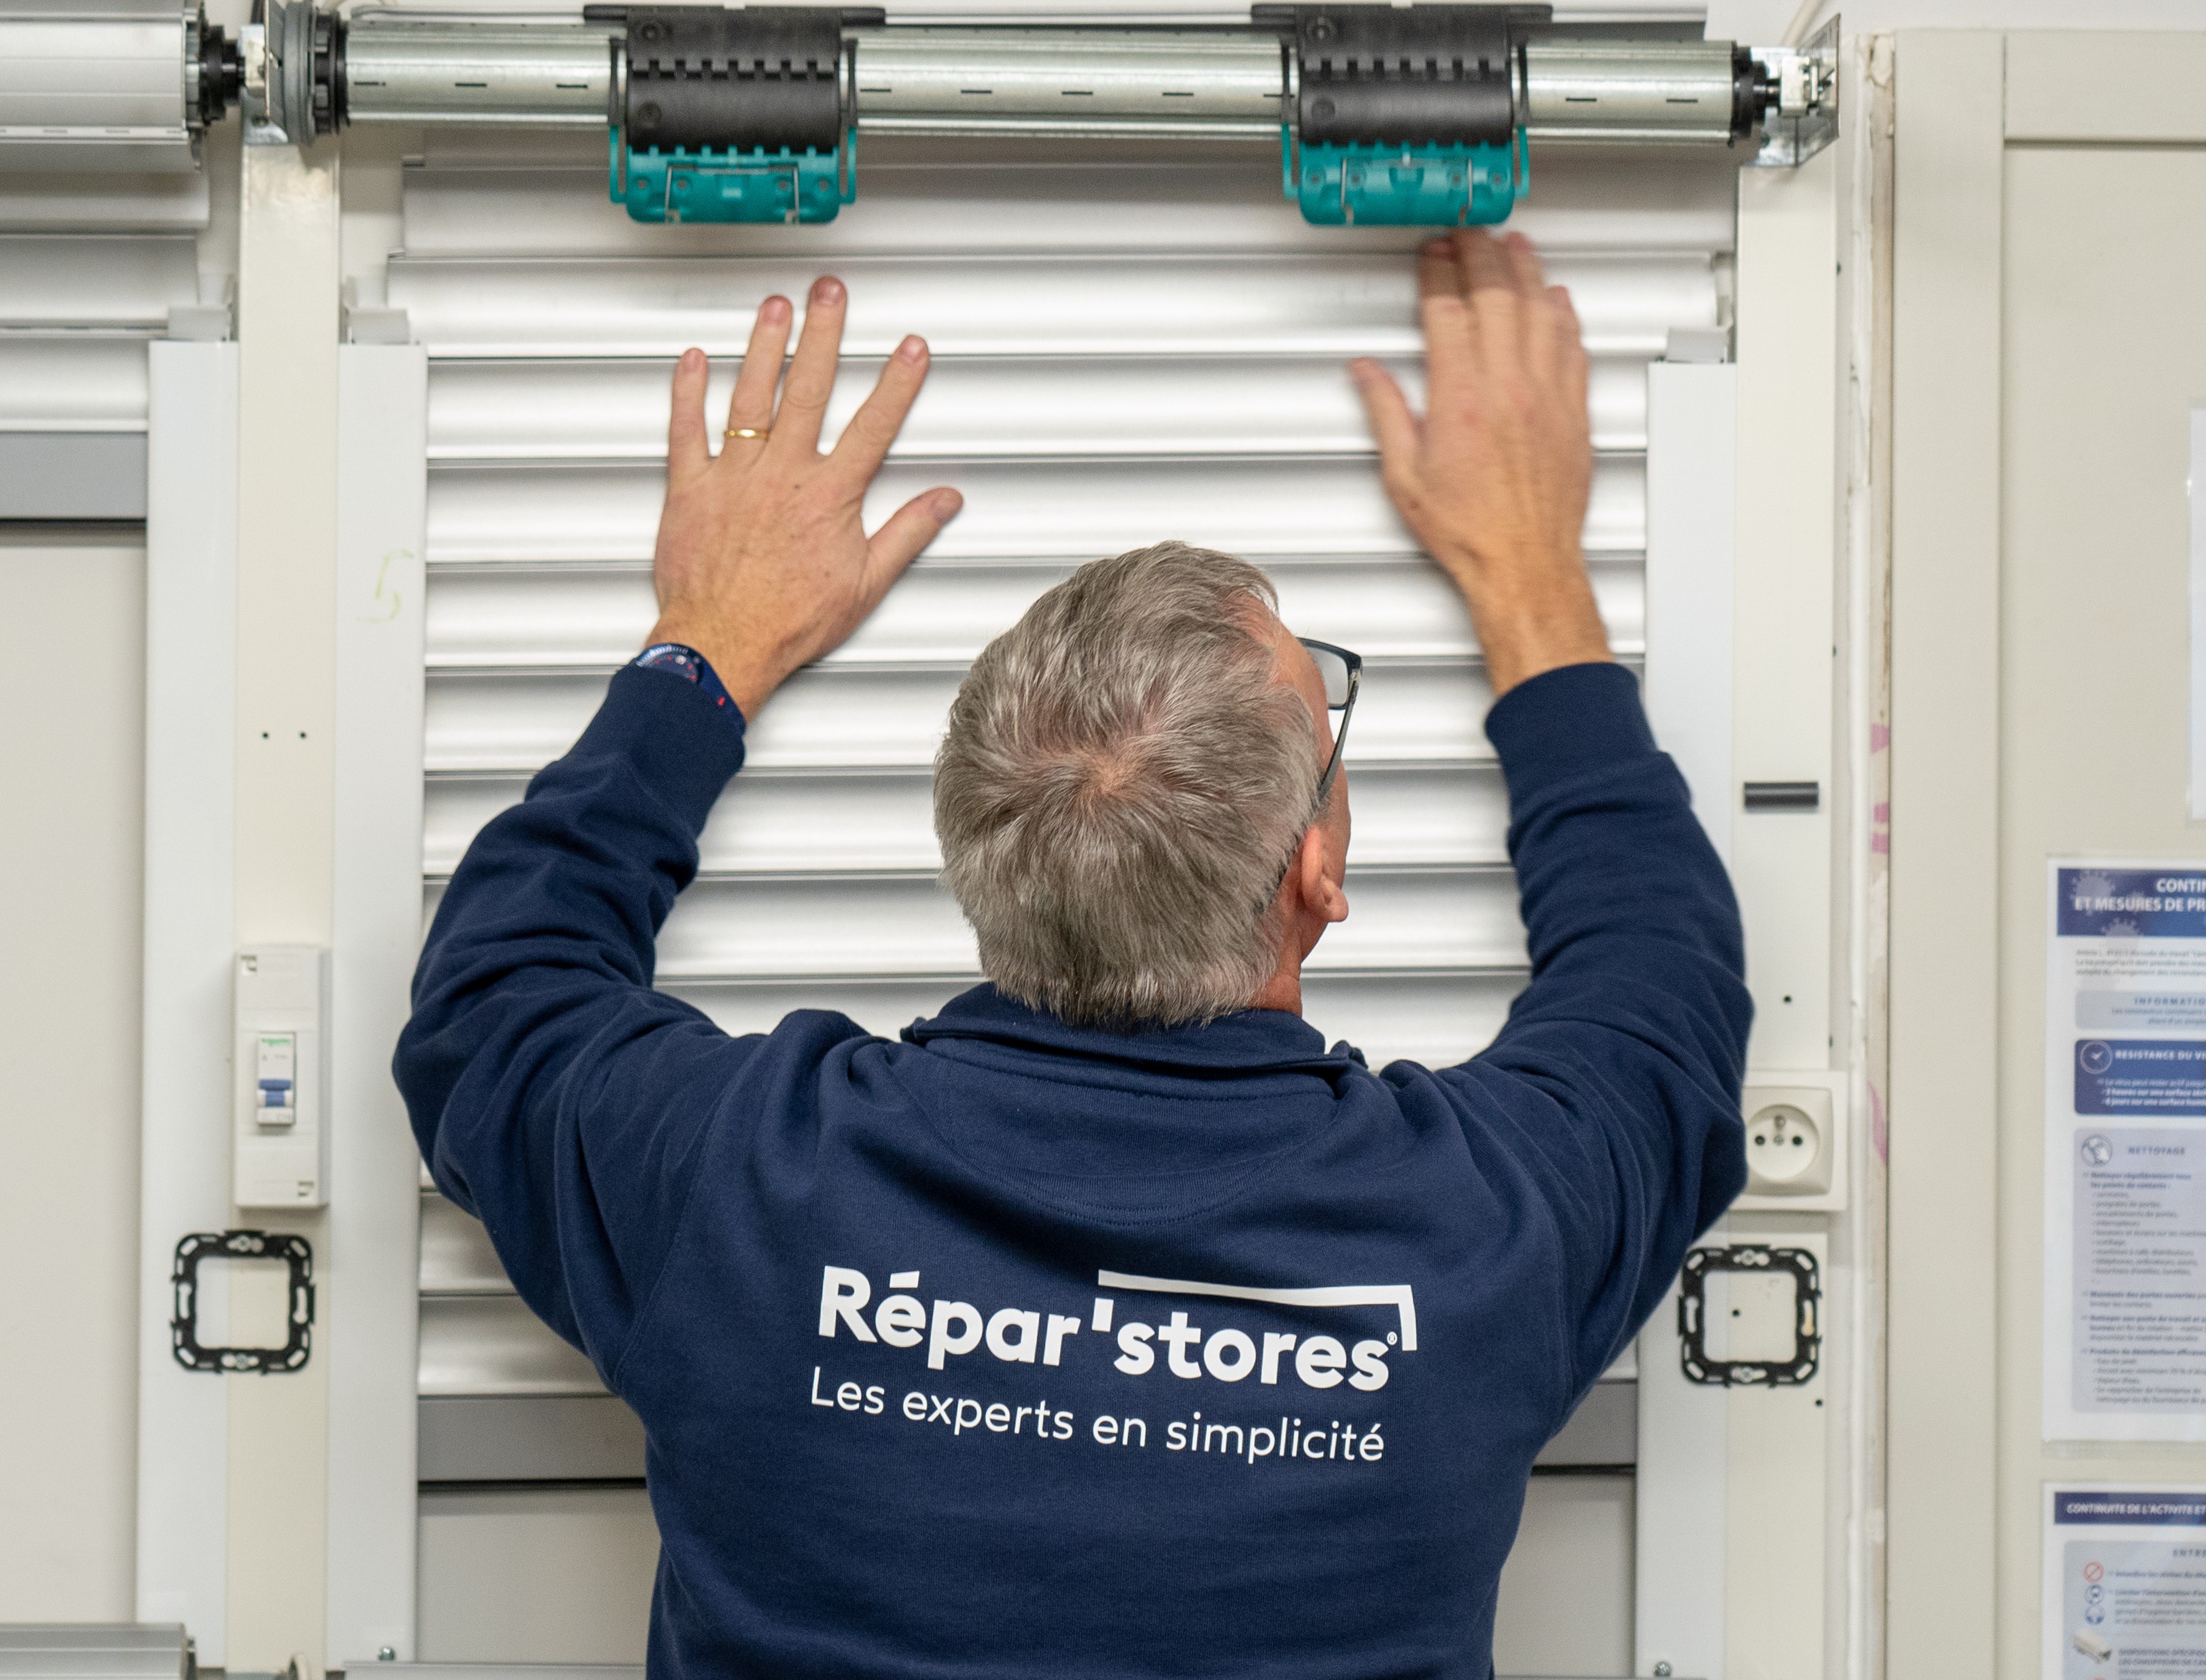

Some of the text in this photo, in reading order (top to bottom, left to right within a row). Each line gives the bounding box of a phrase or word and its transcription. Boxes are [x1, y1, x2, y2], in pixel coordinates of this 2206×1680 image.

[2075, 897, 2091, 911] ET
[2096, 897, 2161, 911] MESURES
[2165, 898, 2184, 912] DE
[2178, 1050, 2193, 1060] DU
[812, 1367, 1384, 1465] Les experts en simplicité
[2128, 1504, 2139, 1514] DE
